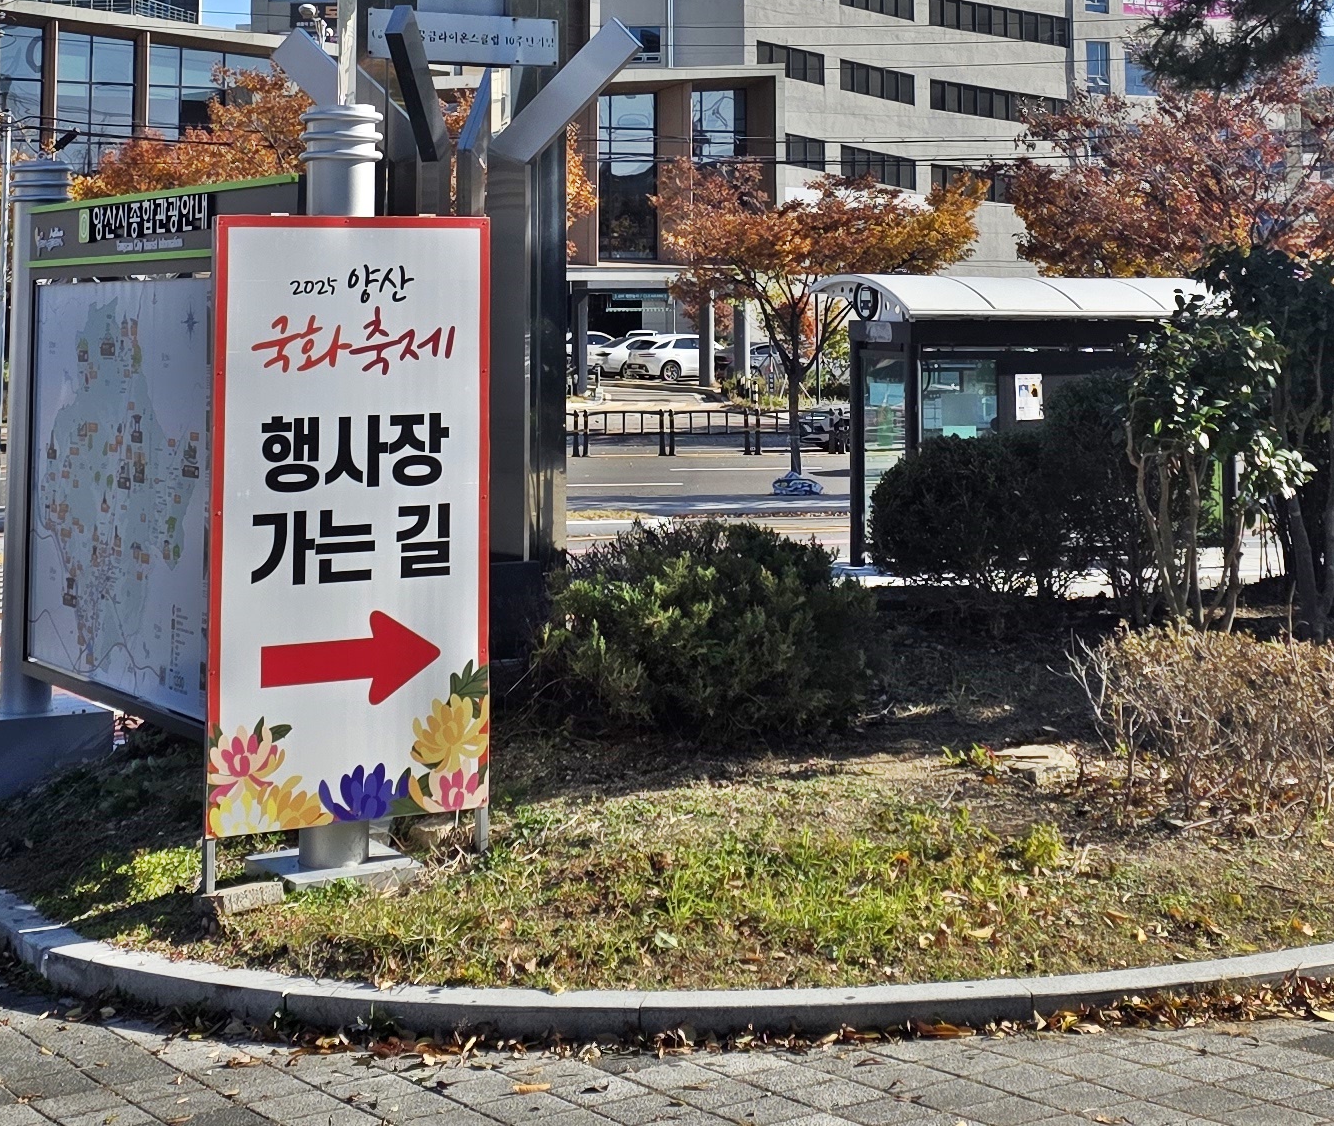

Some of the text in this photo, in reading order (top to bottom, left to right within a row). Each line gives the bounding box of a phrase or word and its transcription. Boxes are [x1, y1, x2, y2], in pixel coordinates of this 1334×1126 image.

[92, 193, 208, 241] 양산시종합관광안내
[289, 263, 415, 304] 2025 양산
[261, 412, 450, 493] 행사장
[251, 502, 451, 585] 가는 길
